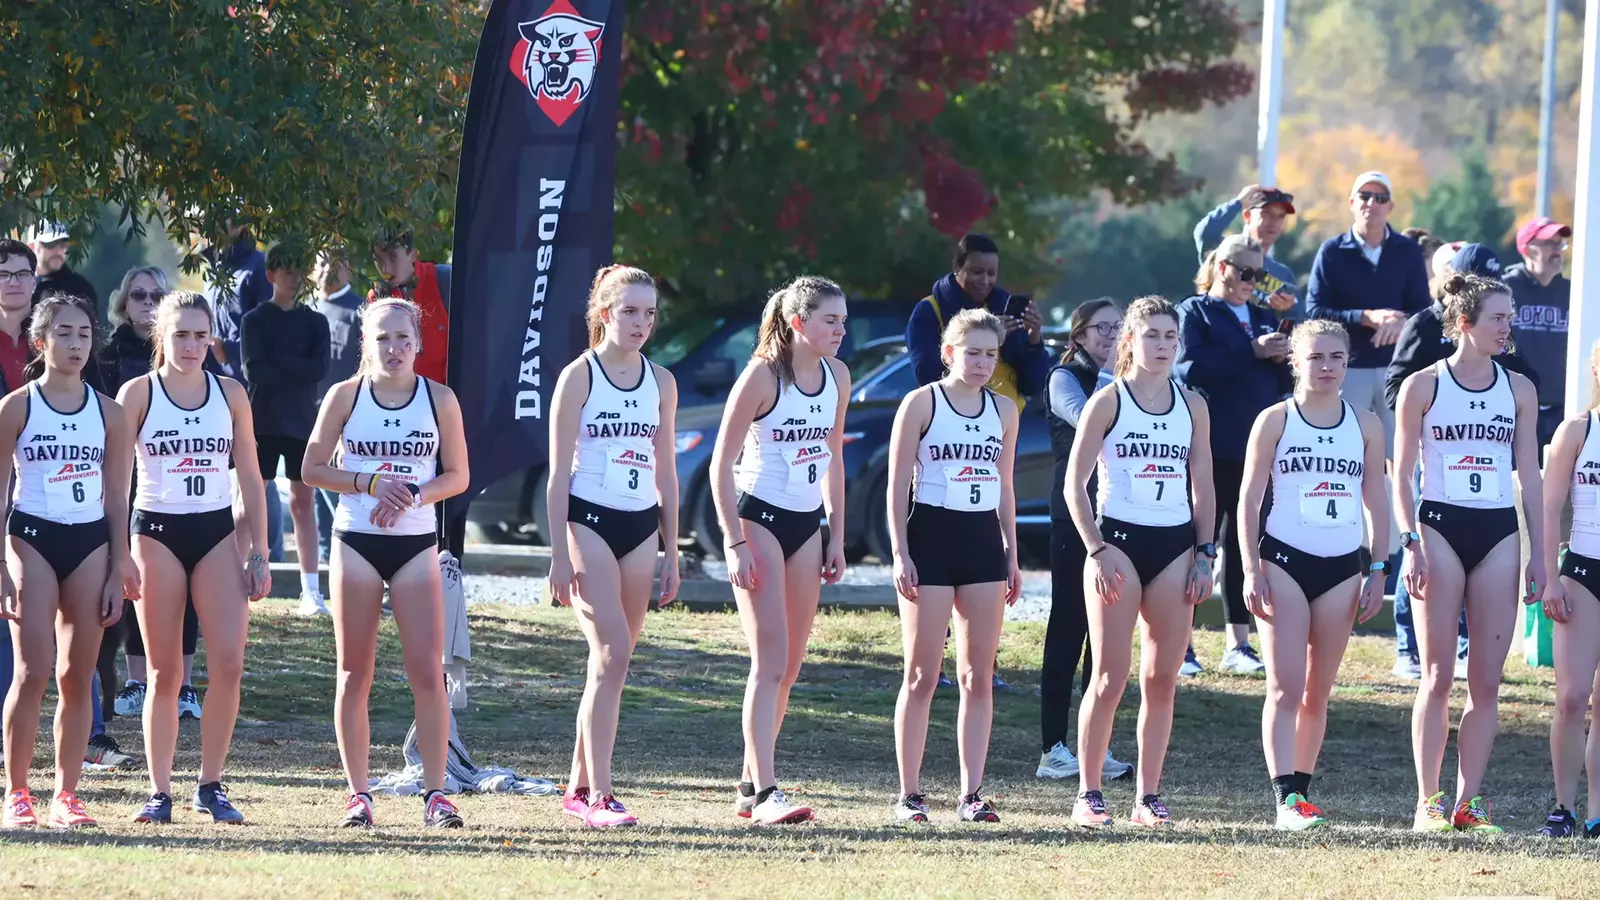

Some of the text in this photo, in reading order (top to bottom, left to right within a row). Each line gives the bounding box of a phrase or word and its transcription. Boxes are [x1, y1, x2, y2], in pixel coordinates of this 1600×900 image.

[515, 178, 566, 419] DAVIDSON
[1511, 305, 1568, 327] LOYOL
[594, 411, 621, 420] A10
[781, 418, 807, 426] A10
[1491, 414, 1514, 424] A10
[30, 434, 57, 442] A10
[151, 429, 179, 439] A10
[405, 430, 434, 438] A10
[772, 427, 833, 442] DAVIDS
[1123, 432, 1149, 440] A10
[1431, 423, 1514, 444] DAVIDSON
[347, 439, 435, 457] DAVIDSON
[796, 445, 822, 459] A10
[929, 443, 1001, 462] DAVIDSO
[1285, 446, 1312, 455] A10
[176, 457, 212, 467] A10
[619, 449, 648, 463] A10
[791, 452, 831, 466] CHAMPIONSHIPS
[1457, 455, 1493, 465] A10
[57, 463, 92, 474] A10
[375, 462, 412, 474] A10
[611, 458, 653, 471] CHAMPIONSHIPS
[957, 466, 991, 477] A10
[1142, 463, 1175, 473] A10
[1448, 465, 1498, 473] CHAMPIONSHIPS
[48, 470, 99, 484] CHAMPIONSHIPS
[628, 468, 639, 490] 3
[808, 463, 817, 485] 8
[183, 475, 206, 497] 10
[1312, 481, 1346, 491] A10
[1469, 472, 1482, 494] 9
[72, 481, 86, 503] 6
[969, 484, 981, 505] 5
[1155, 481, 1164, 501] 7
[1326, 499, 1338, 520] 4
